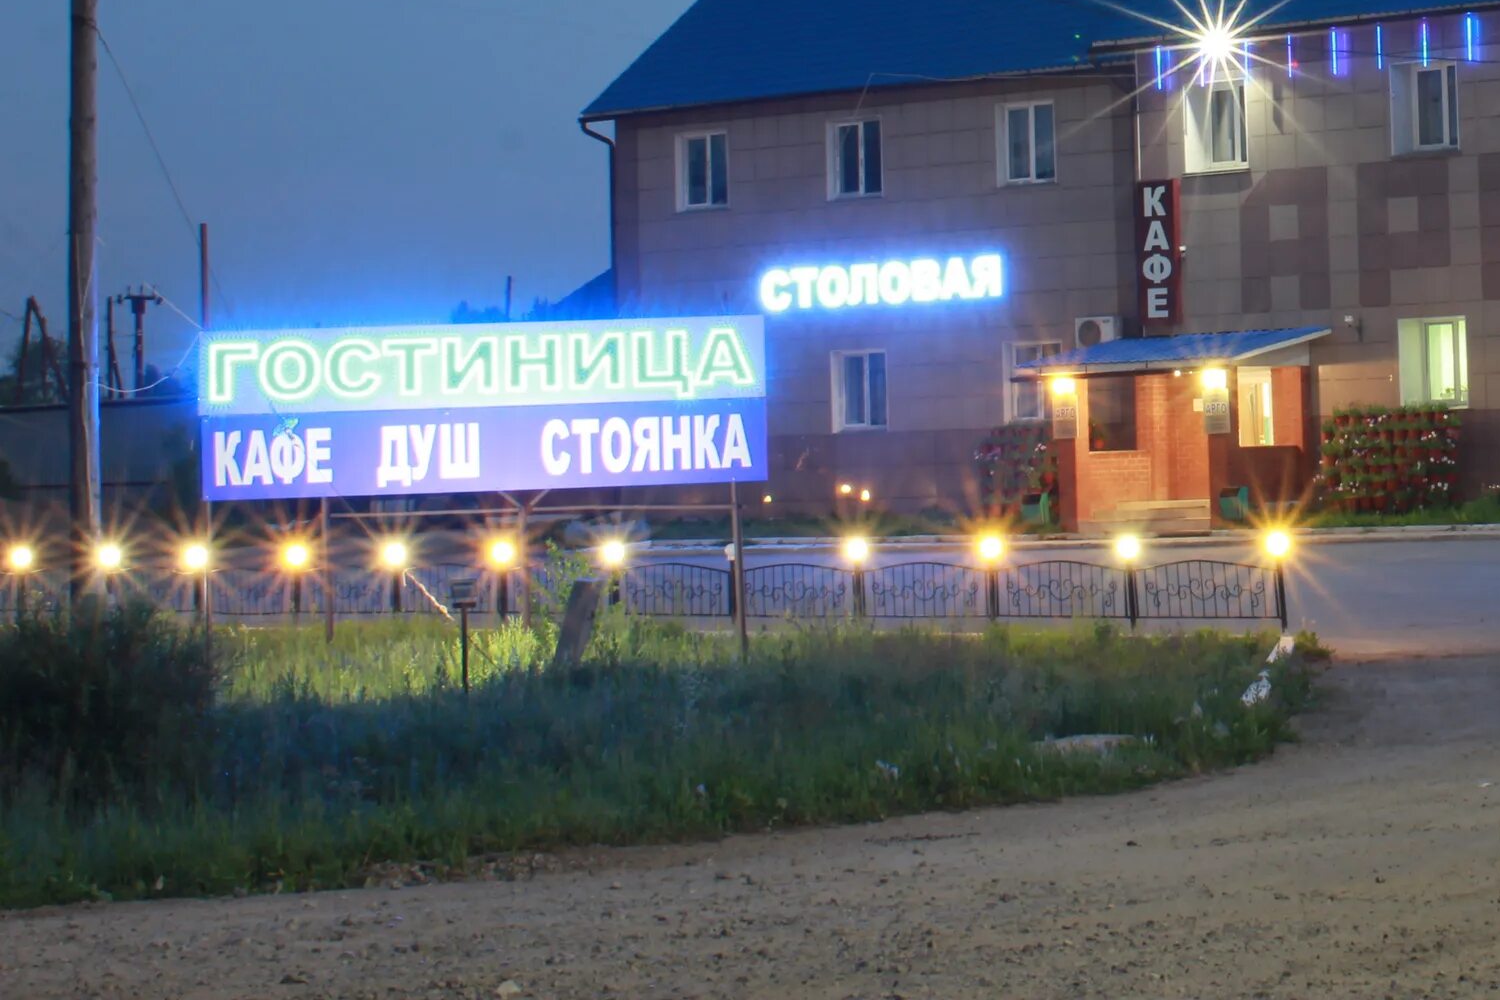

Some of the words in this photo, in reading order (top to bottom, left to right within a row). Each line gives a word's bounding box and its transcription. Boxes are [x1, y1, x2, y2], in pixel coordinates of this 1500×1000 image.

[760, 254, 1002, 312] СТОЛОВАЯ
[1143, 186, 1172, 318] КАФЕ
[207, 327, 754, 403] ГОСТИНИЦА
[214, 427, 332, 486] КАФЕ
[377, 423, 480, 488] ДУШ
[541, 413, 752, 476] СТОЯНКА
